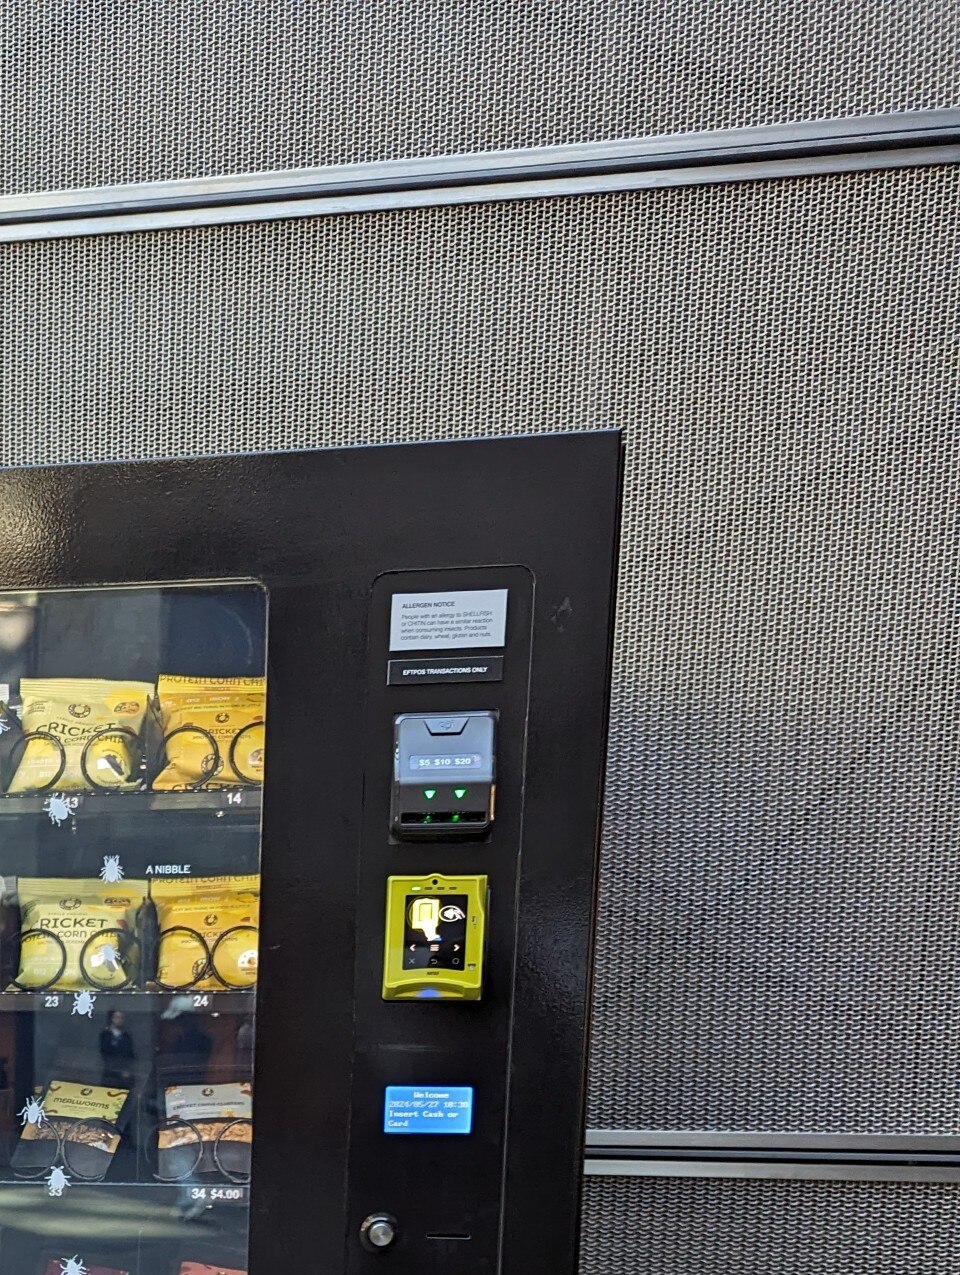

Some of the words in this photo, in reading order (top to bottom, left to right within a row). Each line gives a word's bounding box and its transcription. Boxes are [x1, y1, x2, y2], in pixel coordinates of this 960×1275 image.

[426, 667, 471, 675] TRANSACTIONS
[418, 759, 430, 767] $5
[434, 758, 451, 766] $10
[454, 758, 471, 766] $20
[226, 793, 242, 804] 14
[145, 865, 154, 874] A
[154, 864, 191, 874] NIBBLE
[40, 918, 108, 928] RICKET
[44, 996, 59, 1007] 23
[193, 995, 209, 1007] 24
[414, 1091, 449, 1099] Welcome
[53, 1097, 110, 1110] MEALWORMS
[389, 1110, 419, 1118] Insert
[191, 1188, 206, 1199] 34
[210, 1189, 240, 1200] $4.00
